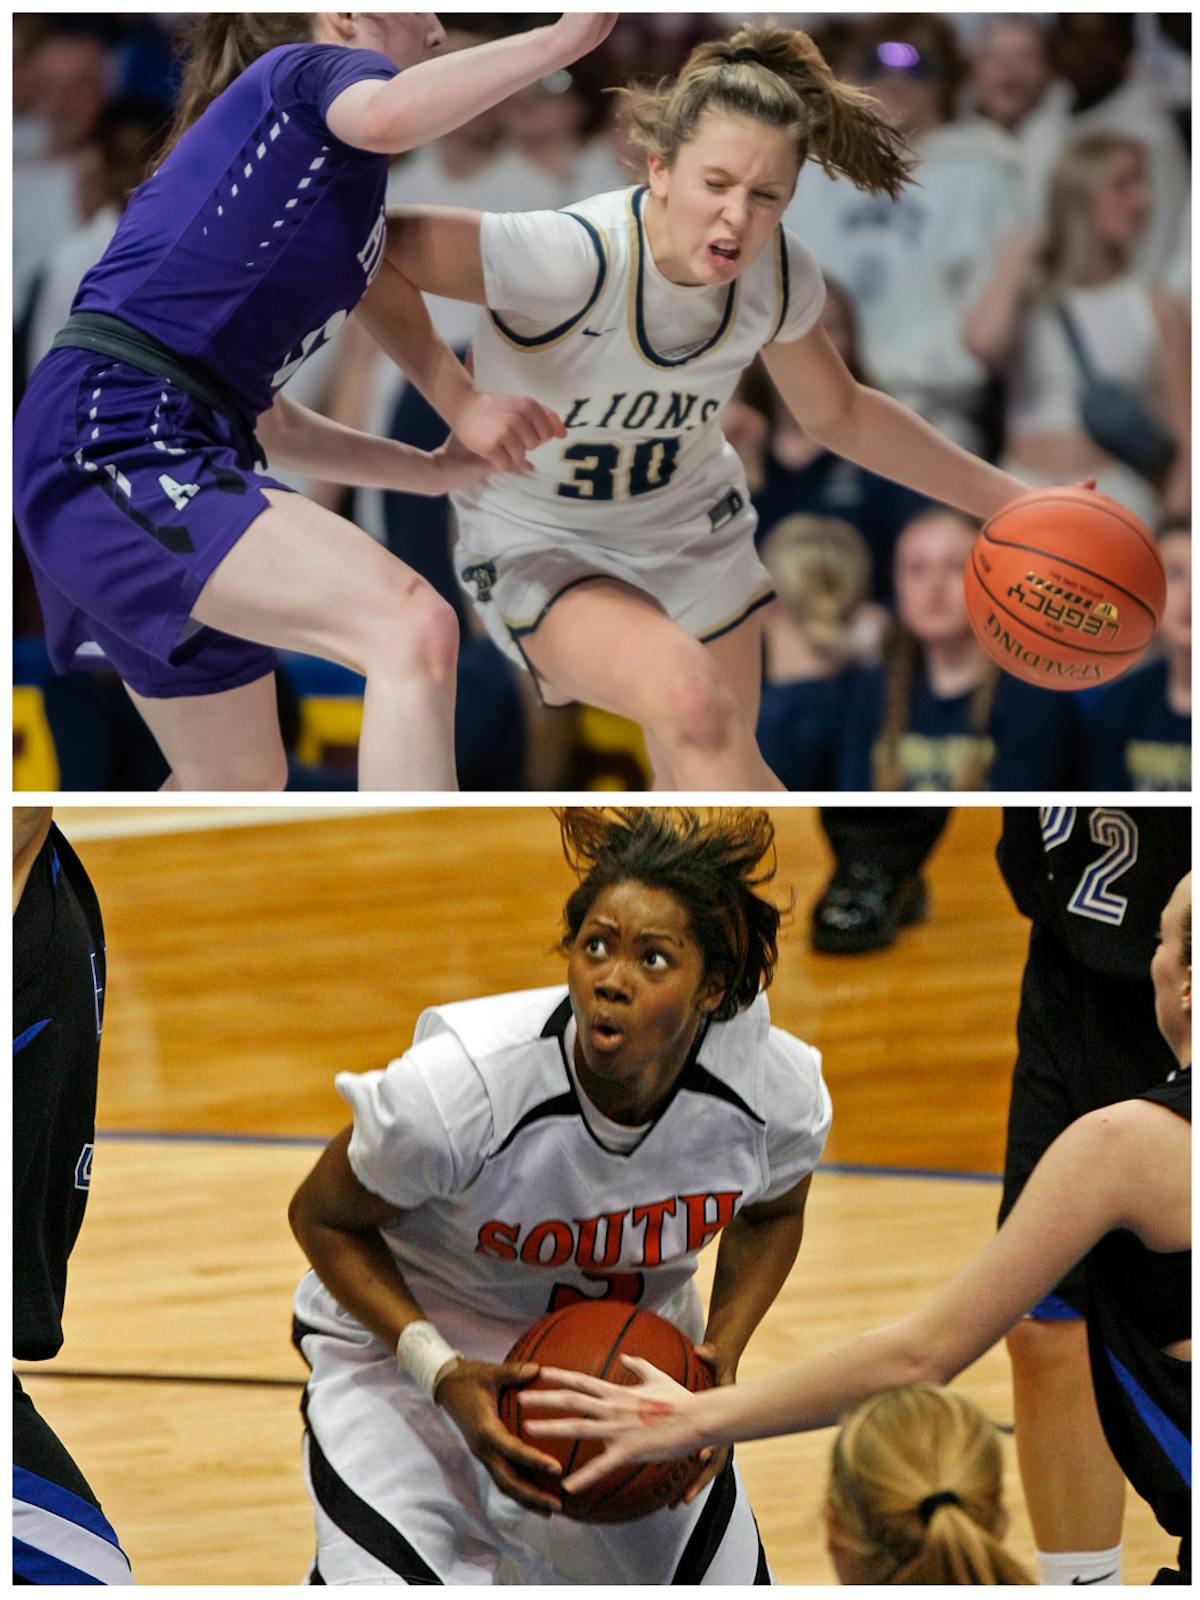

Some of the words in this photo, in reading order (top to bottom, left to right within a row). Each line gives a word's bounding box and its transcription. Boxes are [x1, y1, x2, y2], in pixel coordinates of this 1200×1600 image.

[563, 389, 721, 432] LIONS
[157, 472, 201, 512] A
[554, 434, 682, 503] 30
[1007, 583, 1121, 642] LEGACY
[986, 611, 1104, 680] SPALDING
[475, 1190, 743, 1268] SOUTH
